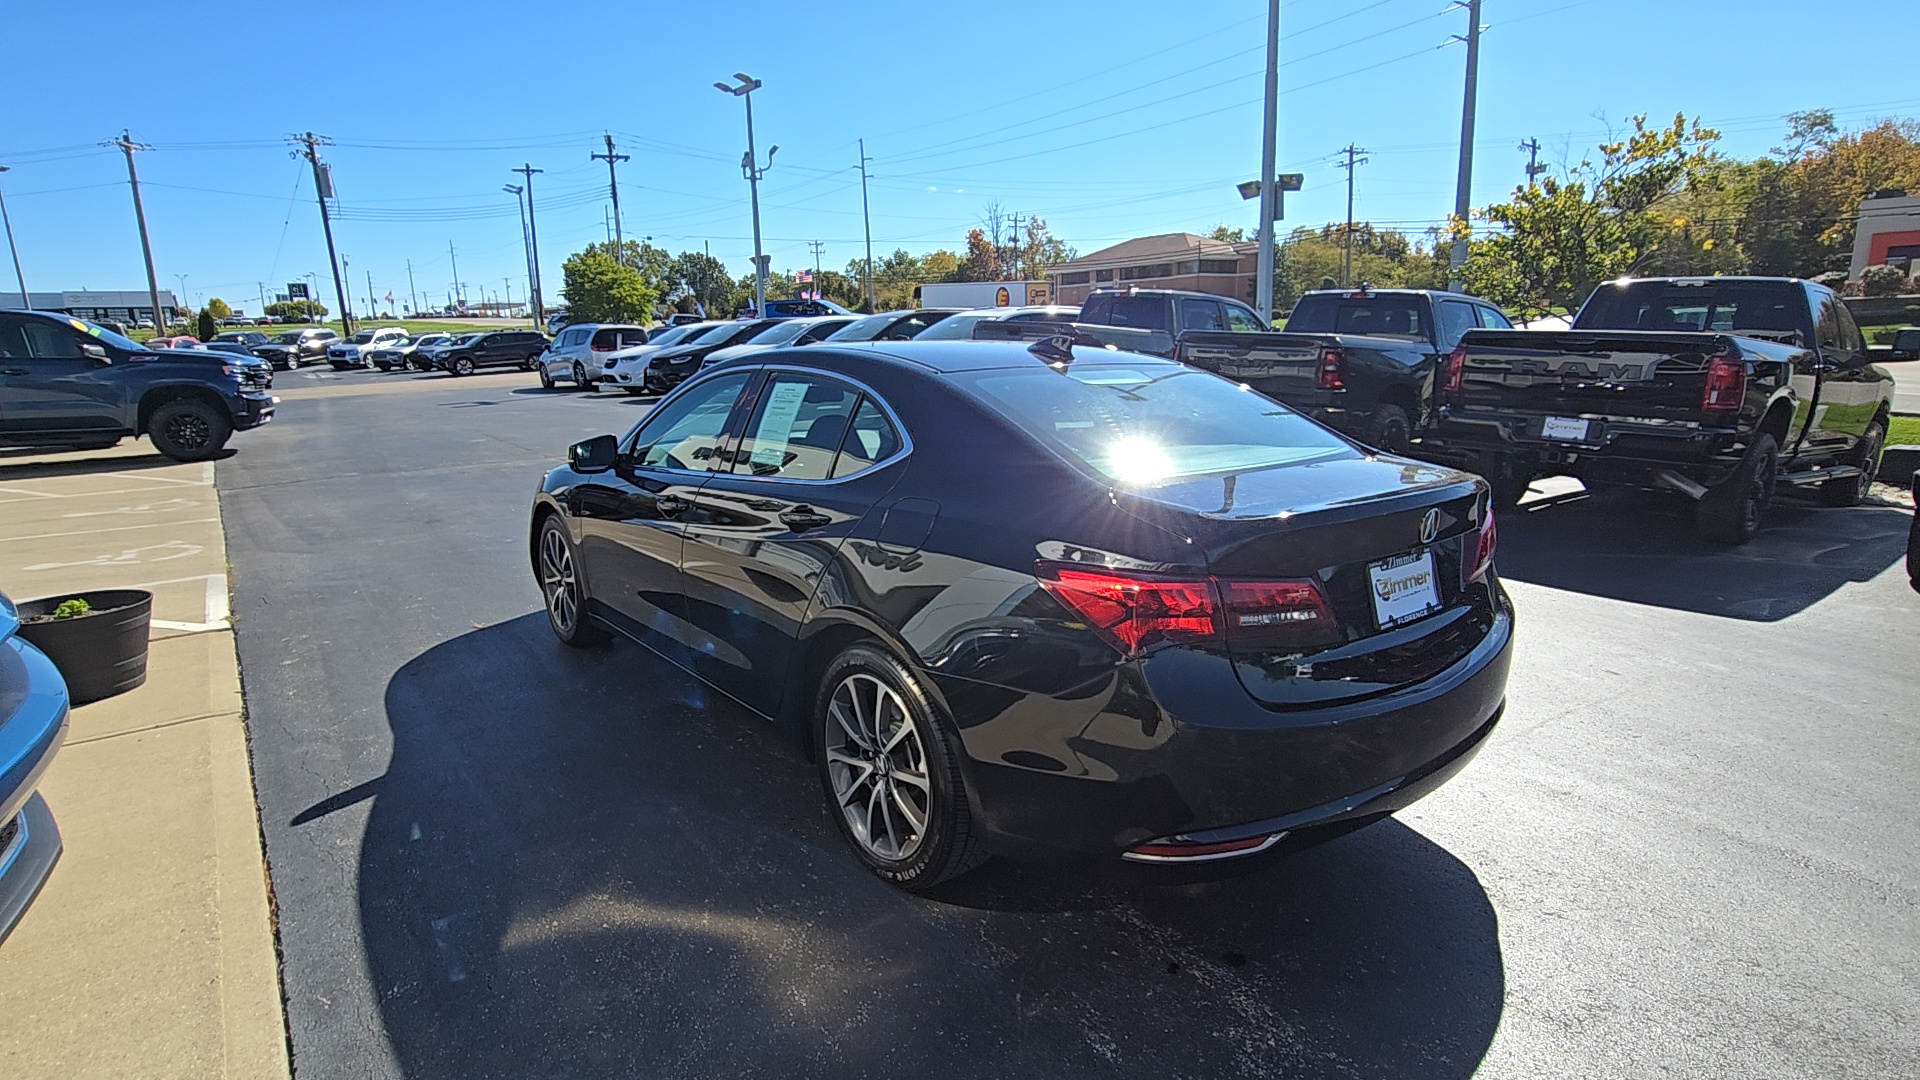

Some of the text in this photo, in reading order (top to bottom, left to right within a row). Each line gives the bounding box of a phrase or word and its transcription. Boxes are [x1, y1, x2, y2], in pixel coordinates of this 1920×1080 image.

[1511, 360, 1645, 380] RAM
[1387, 553, 1418, 569] Zimmer
[1377, 571, 1431, 599] Zimmer
[1397, 609, 1429, 625] FLORENCE
